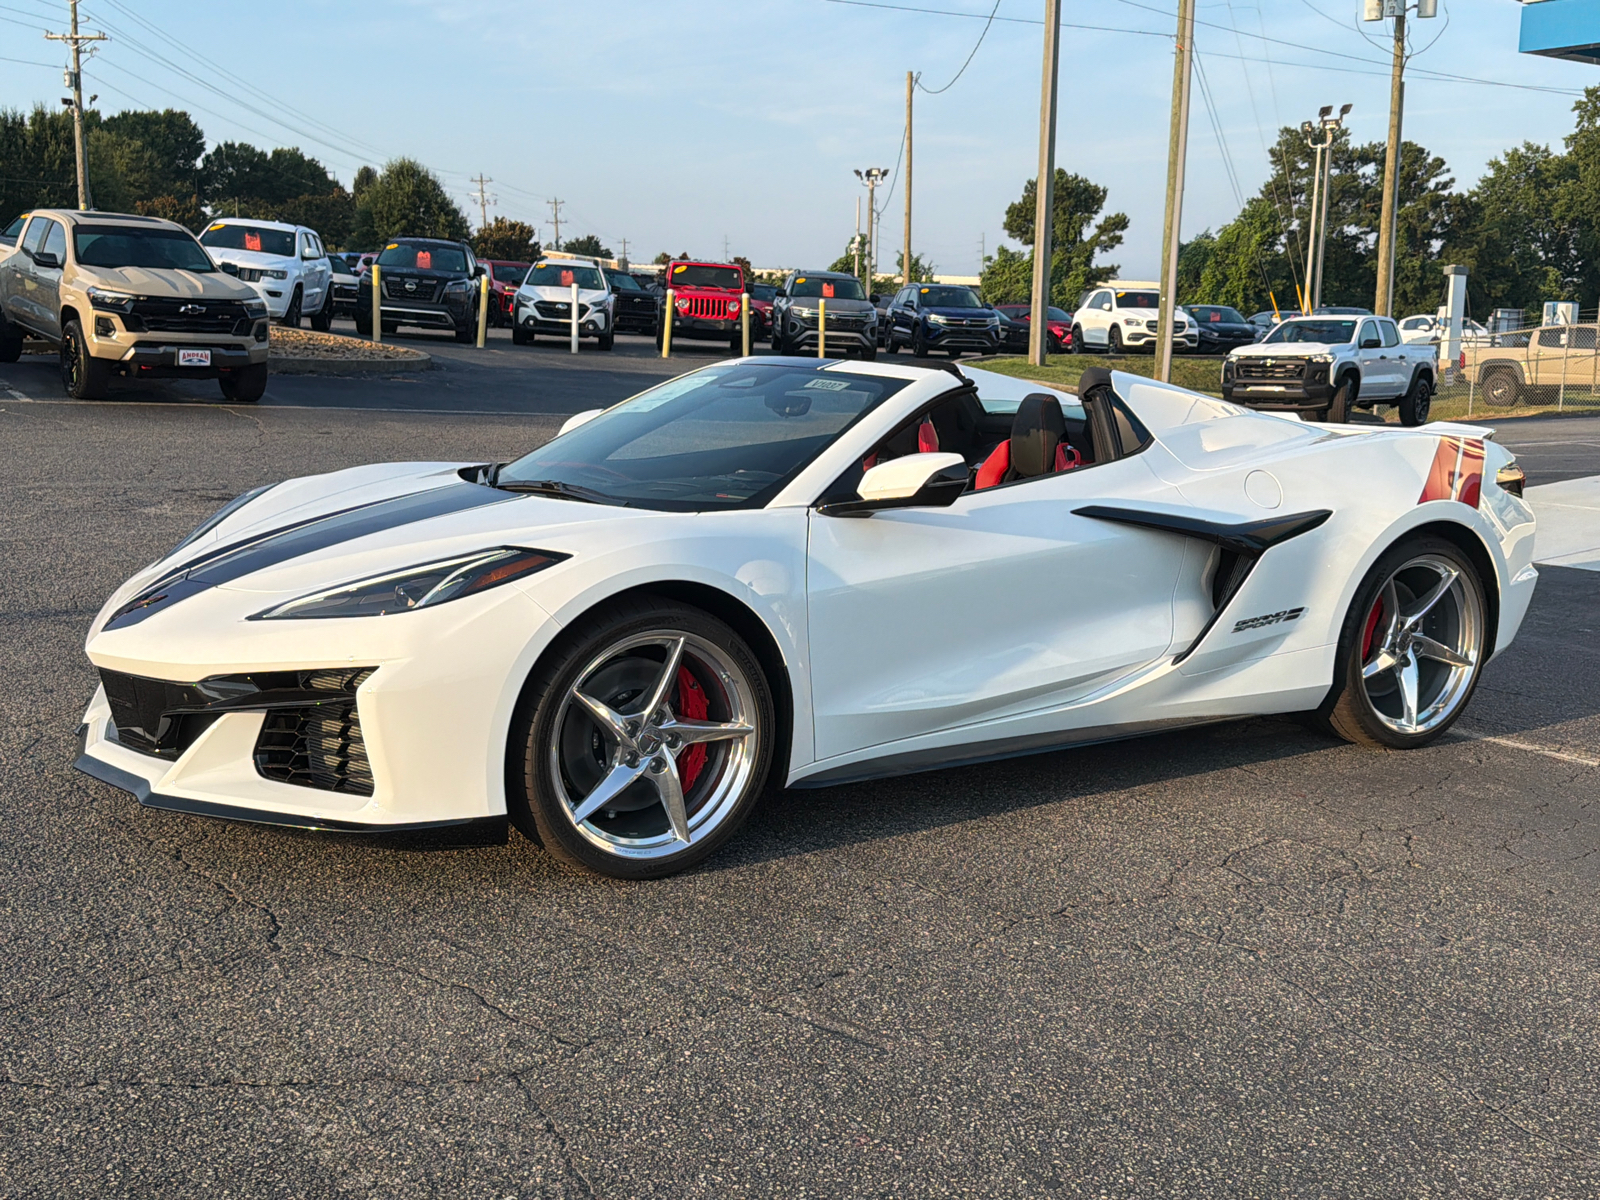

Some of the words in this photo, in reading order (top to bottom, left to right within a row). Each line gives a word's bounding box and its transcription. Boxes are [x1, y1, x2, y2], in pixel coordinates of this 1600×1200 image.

[182, 352, 209, 362] ANDEAN
[1230, 617, 1283, 633] SPORT
[1235, 610, 1288, 626] GRAND
[739, 652, 764, 697] MICHELIN
